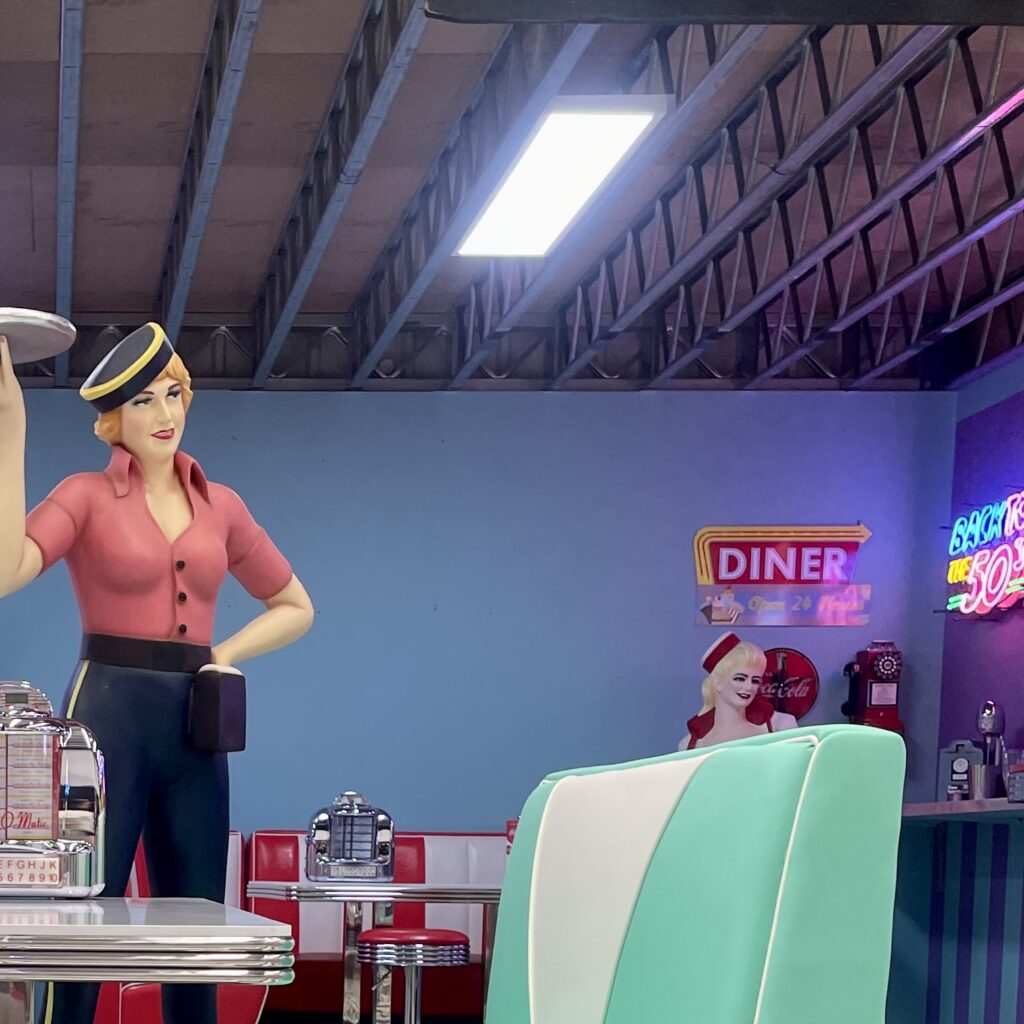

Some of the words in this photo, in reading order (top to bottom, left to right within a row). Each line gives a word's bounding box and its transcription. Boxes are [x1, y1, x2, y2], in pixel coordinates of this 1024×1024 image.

[949, 500, 1008, 556] BACK
[718, 547, 851, 581] DINER
[947, 556, 974, 584] THE
